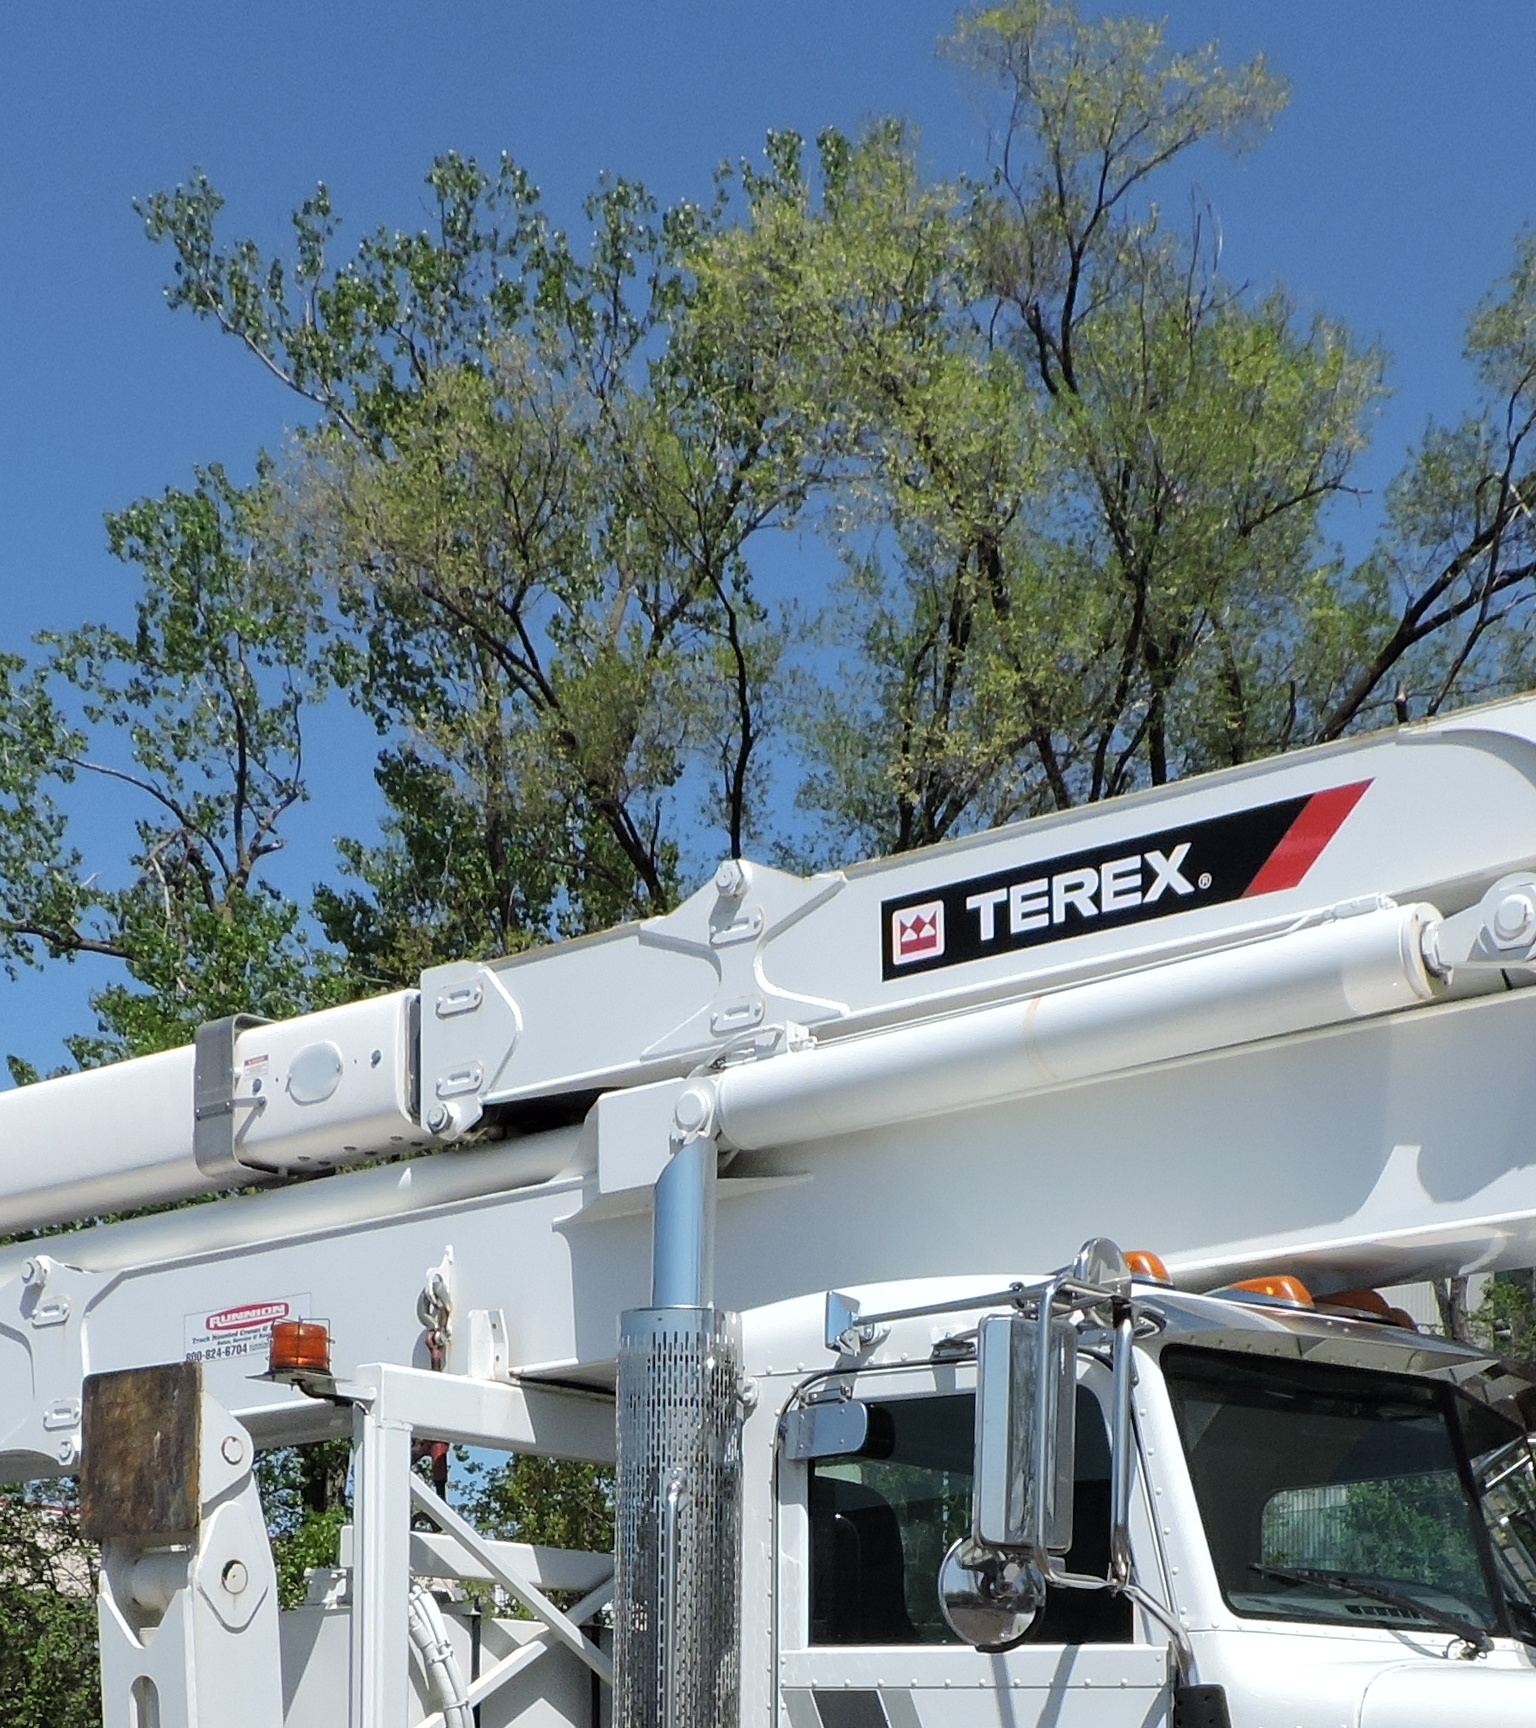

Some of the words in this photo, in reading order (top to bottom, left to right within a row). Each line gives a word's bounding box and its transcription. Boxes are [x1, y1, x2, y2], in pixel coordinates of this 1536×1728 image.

[966, 842, 1195, 940] TEREX
[209, 1304, 286, 1329] RUNNION
[186, 1344, 248, 1362] 800-824-6704
